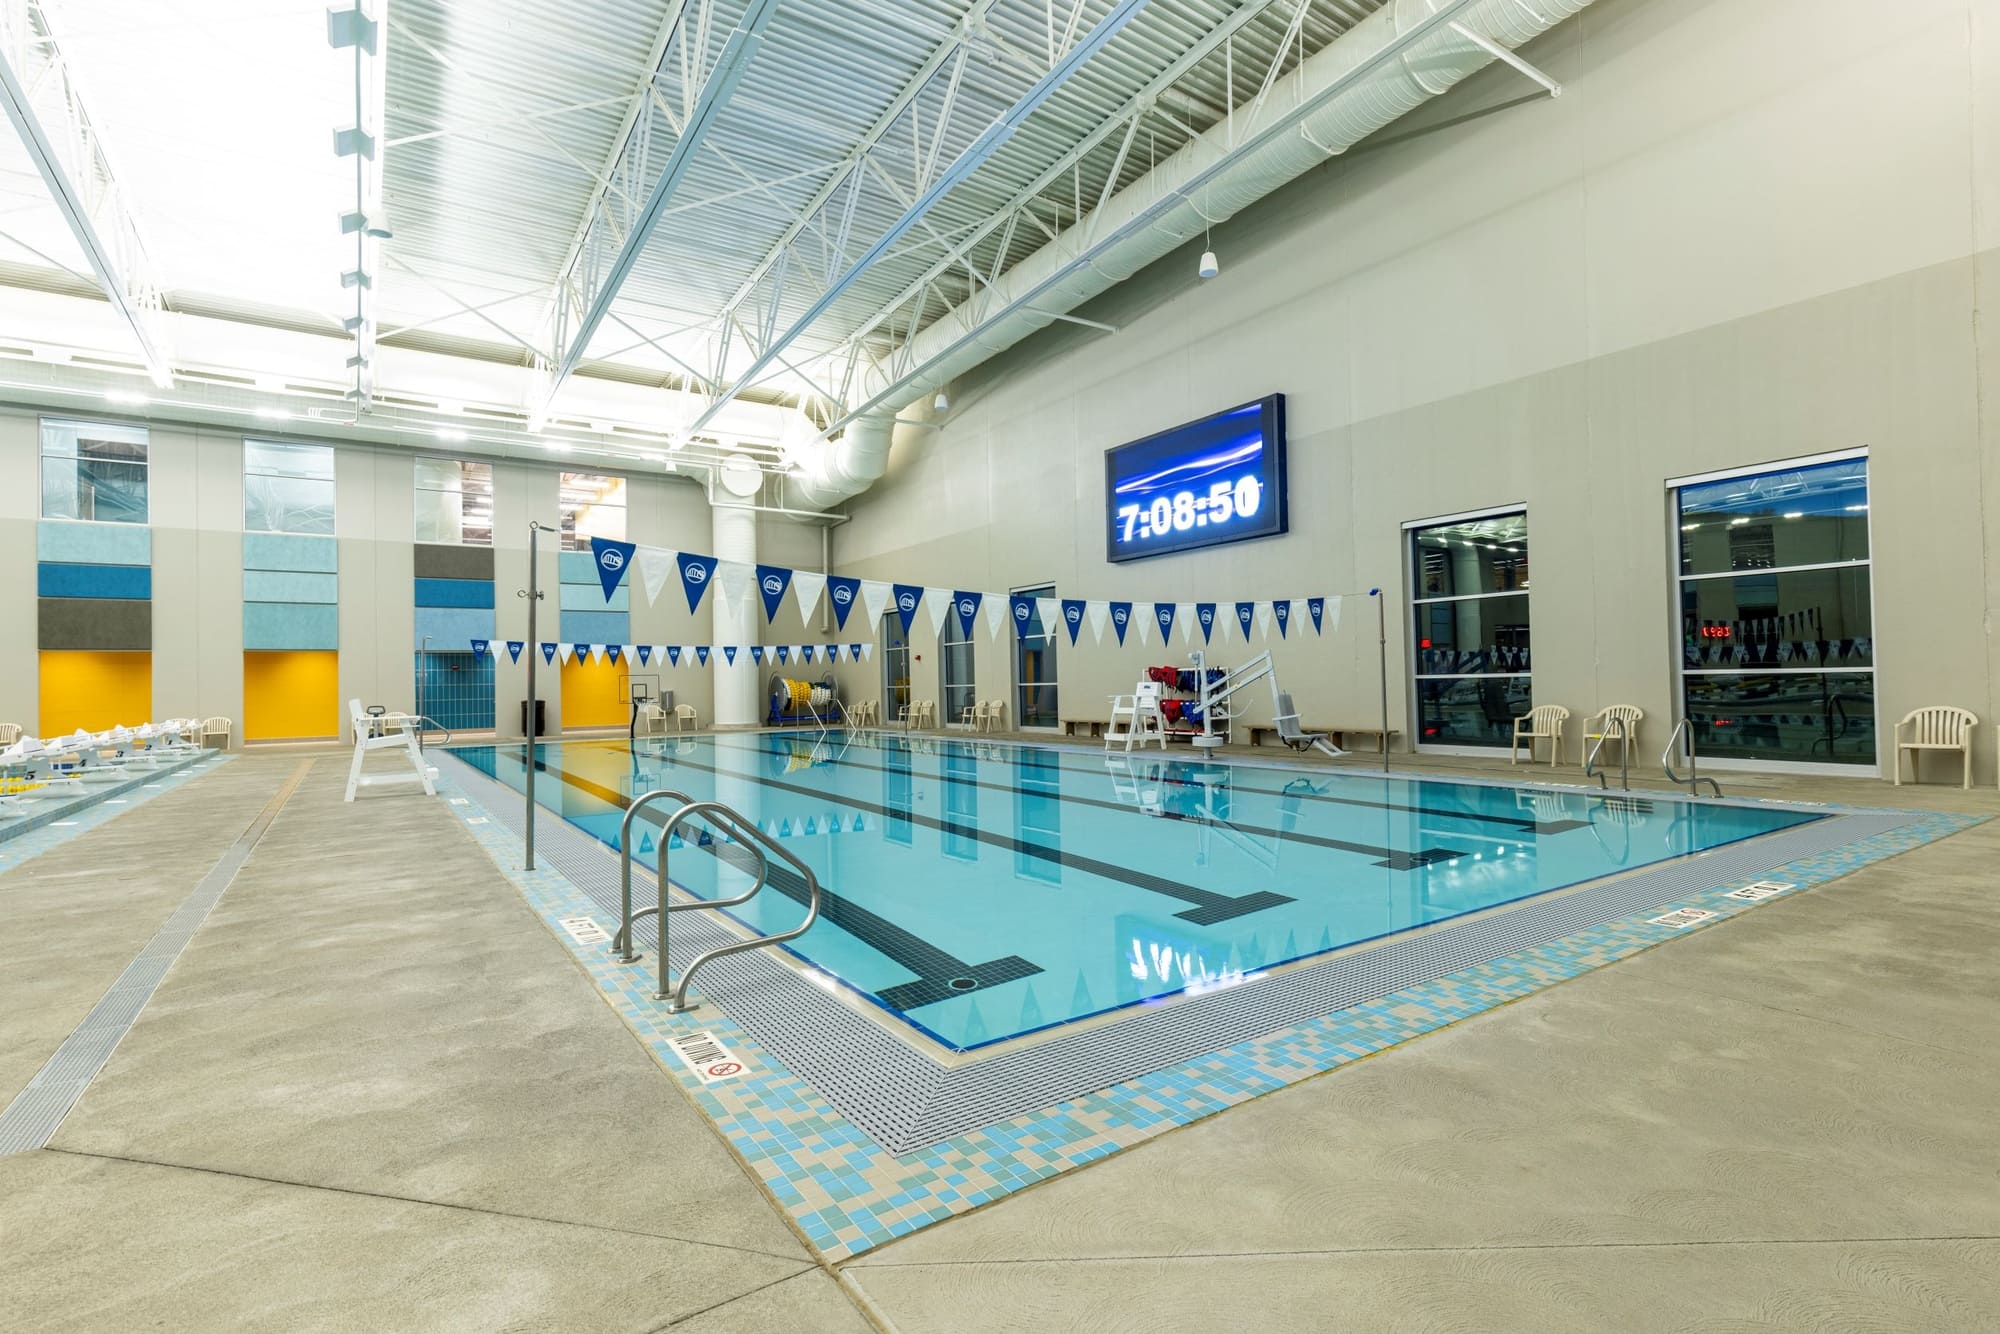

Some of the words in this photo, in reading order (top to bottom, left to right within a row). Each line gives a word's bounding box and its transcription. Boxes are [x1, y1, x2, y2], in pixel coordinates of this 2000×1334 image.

[1117, 475, 1261, 542] 7:08:50
[115, 750, 124, 758] 3
[24, 771, 36, 781] 5
